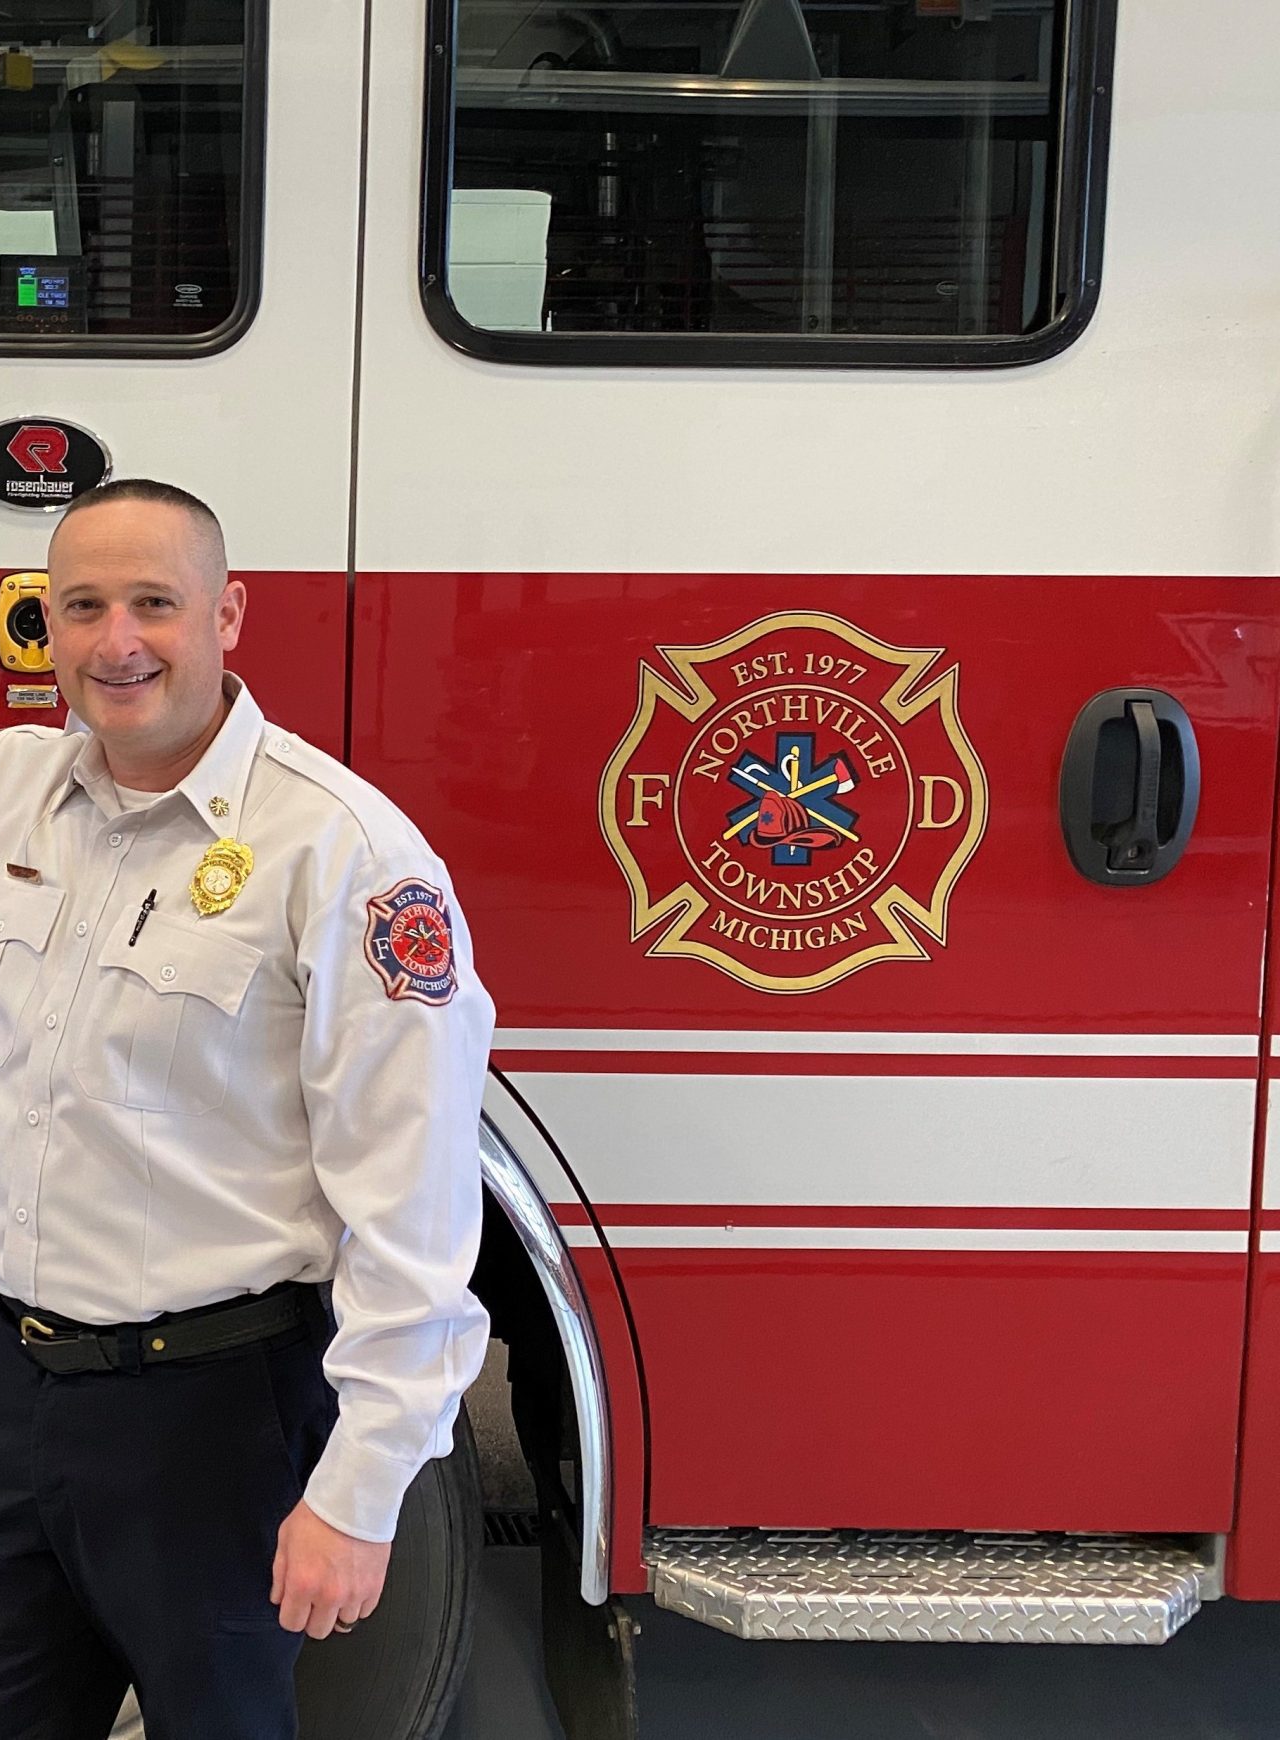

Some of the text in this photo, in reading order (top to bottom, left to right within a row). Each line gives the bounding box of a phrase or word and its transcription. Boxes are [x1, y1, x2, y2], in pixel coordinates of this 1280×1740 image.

[6, 475, 74, 493] rosenbauer
[730, 651, 868, 687] EST. 1977
[691, 694, 897, 783] NORTHVILLE
[626, 774, 671, 827] F
[917, 775, 965, 829] D
[700, 841, 880, 910] TOWNSHIP
[394, 891, 433, 908] EST. 1977
[373, 937, 390, 960] F
[709, 911, 869, 951] MICHIGAN
